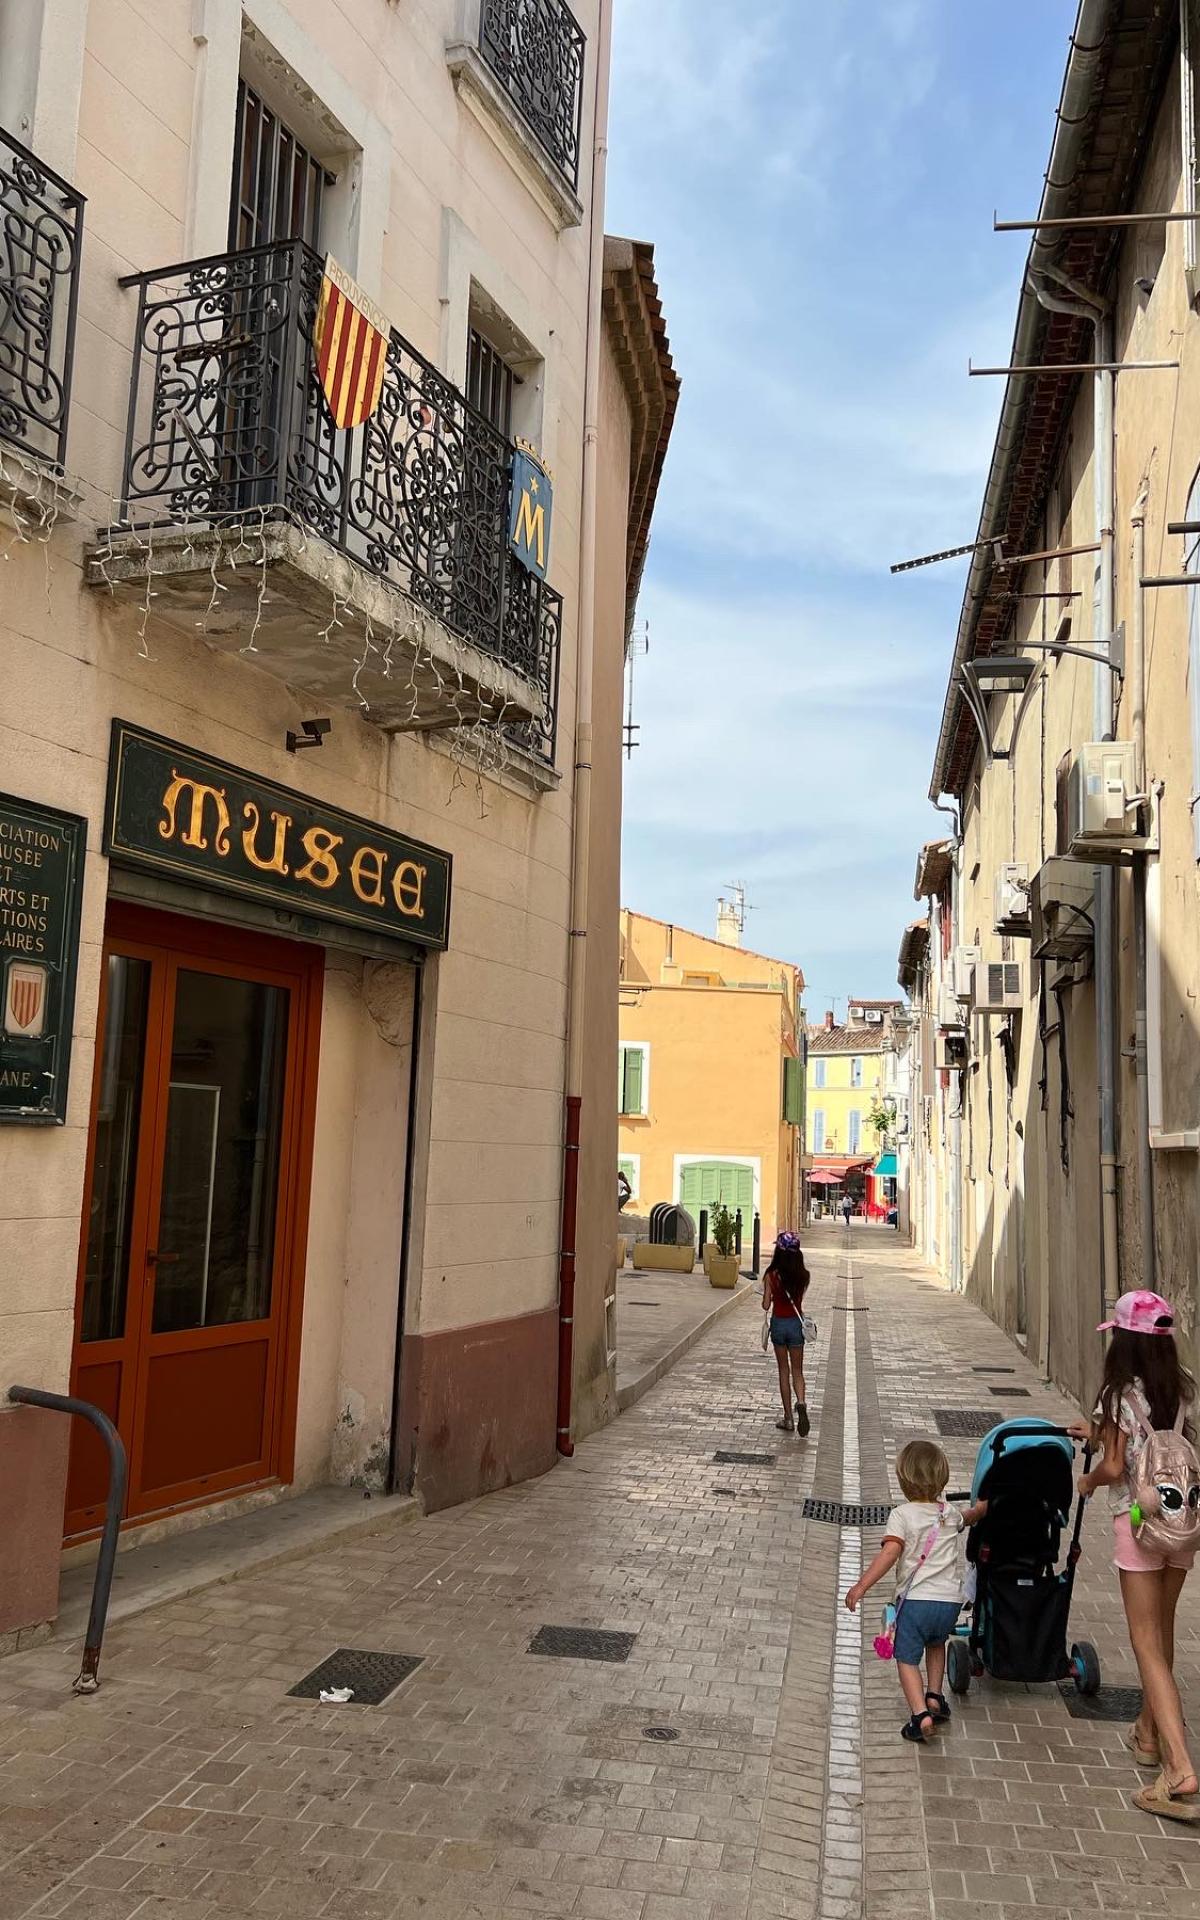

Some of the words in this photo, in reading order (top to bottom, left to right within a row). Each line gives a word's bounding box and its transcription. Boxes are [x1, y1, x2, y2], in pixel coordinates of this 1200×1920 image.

[512, 488, 545, 571] M
[158, 767, 428, 918] MUSEE
[31, 894, 50, 912] ET
[1, 909, 47, 932] TIONS
[0, 930, 45, 953] AIRES
